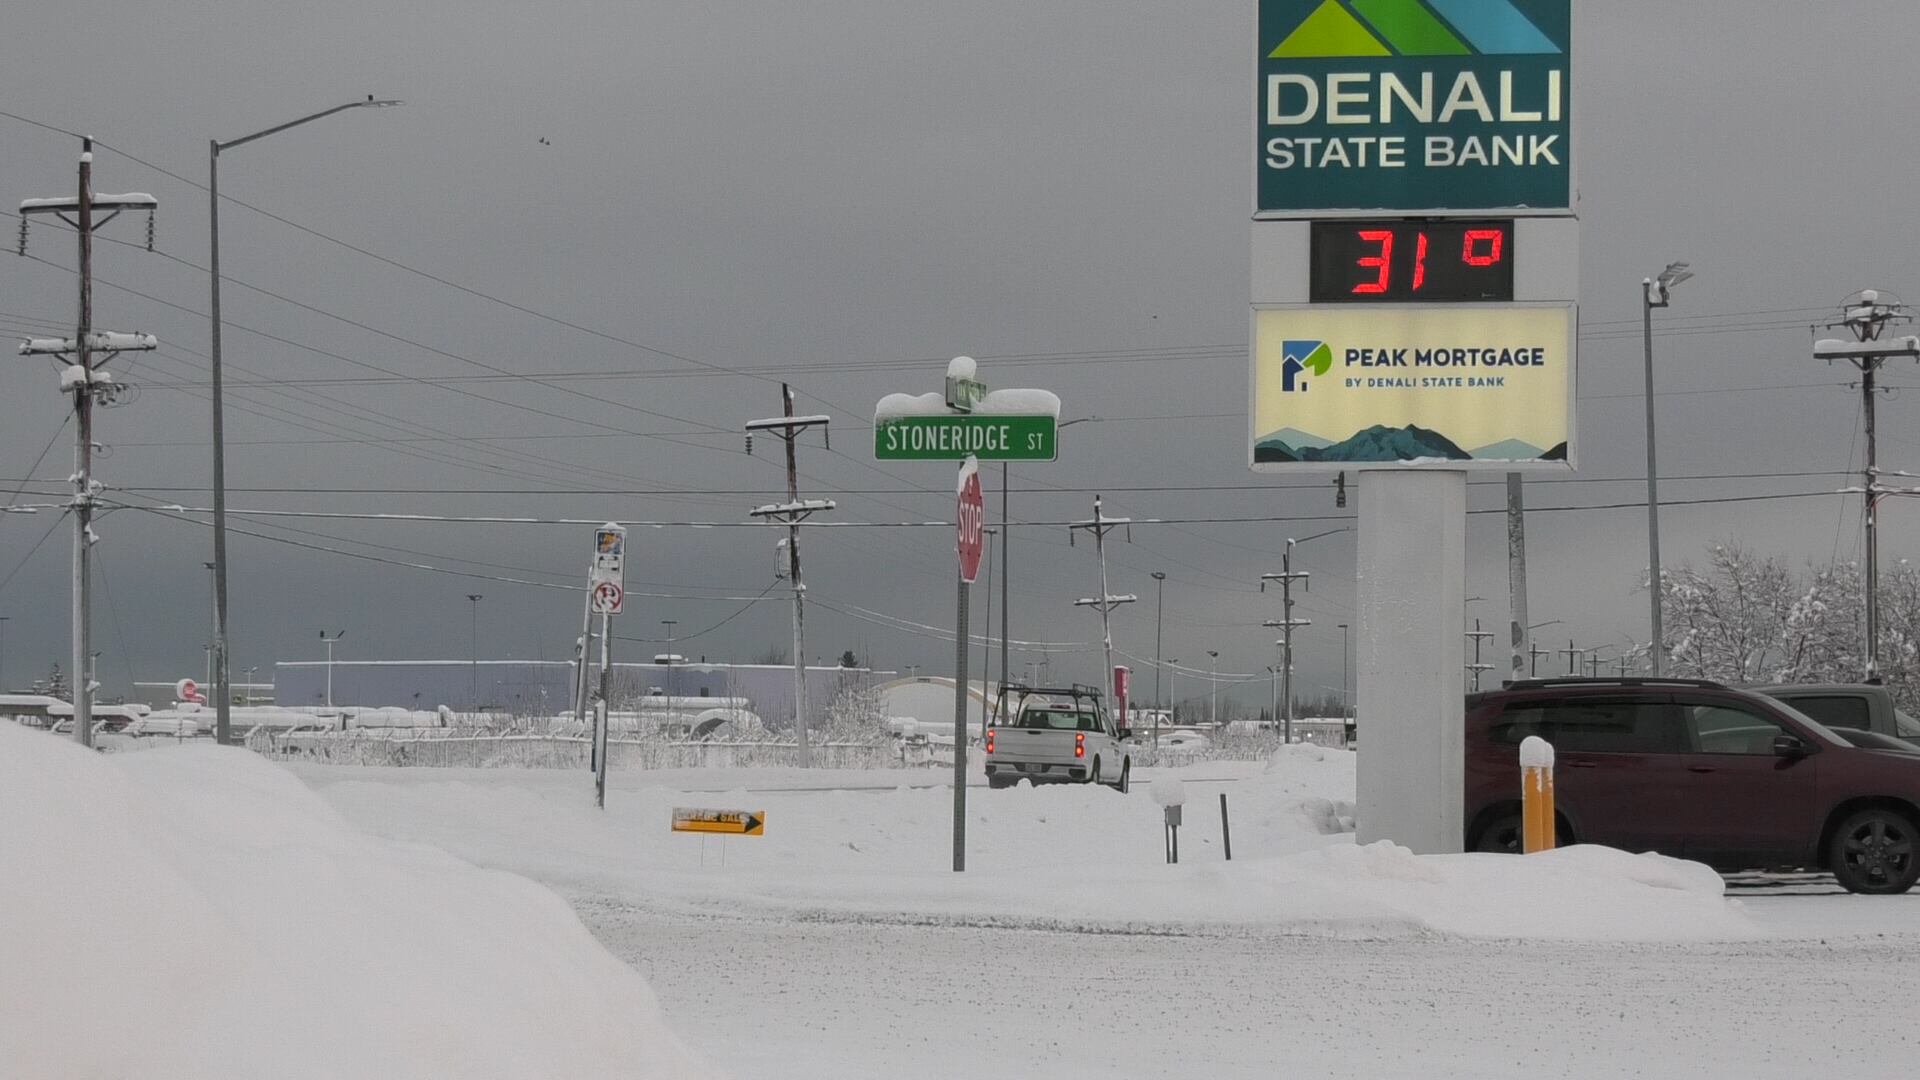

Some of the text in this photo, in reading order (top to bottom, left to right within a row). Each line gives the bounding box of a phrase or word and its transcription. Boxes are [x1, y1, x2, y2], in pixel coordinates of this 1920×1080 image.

[1267, 70, 1561, 124] DENALI
[1266, 135, 1560, 169] STATE BANK
[1345, 347, 1545, 366] PEAK MORTGAGE
[1345, 377, 1505, 387] BY DENALI STATE BANK
[886, 425, 1043, 450] STONERIDGE ST
[959, 501, 981, 545] STOP
